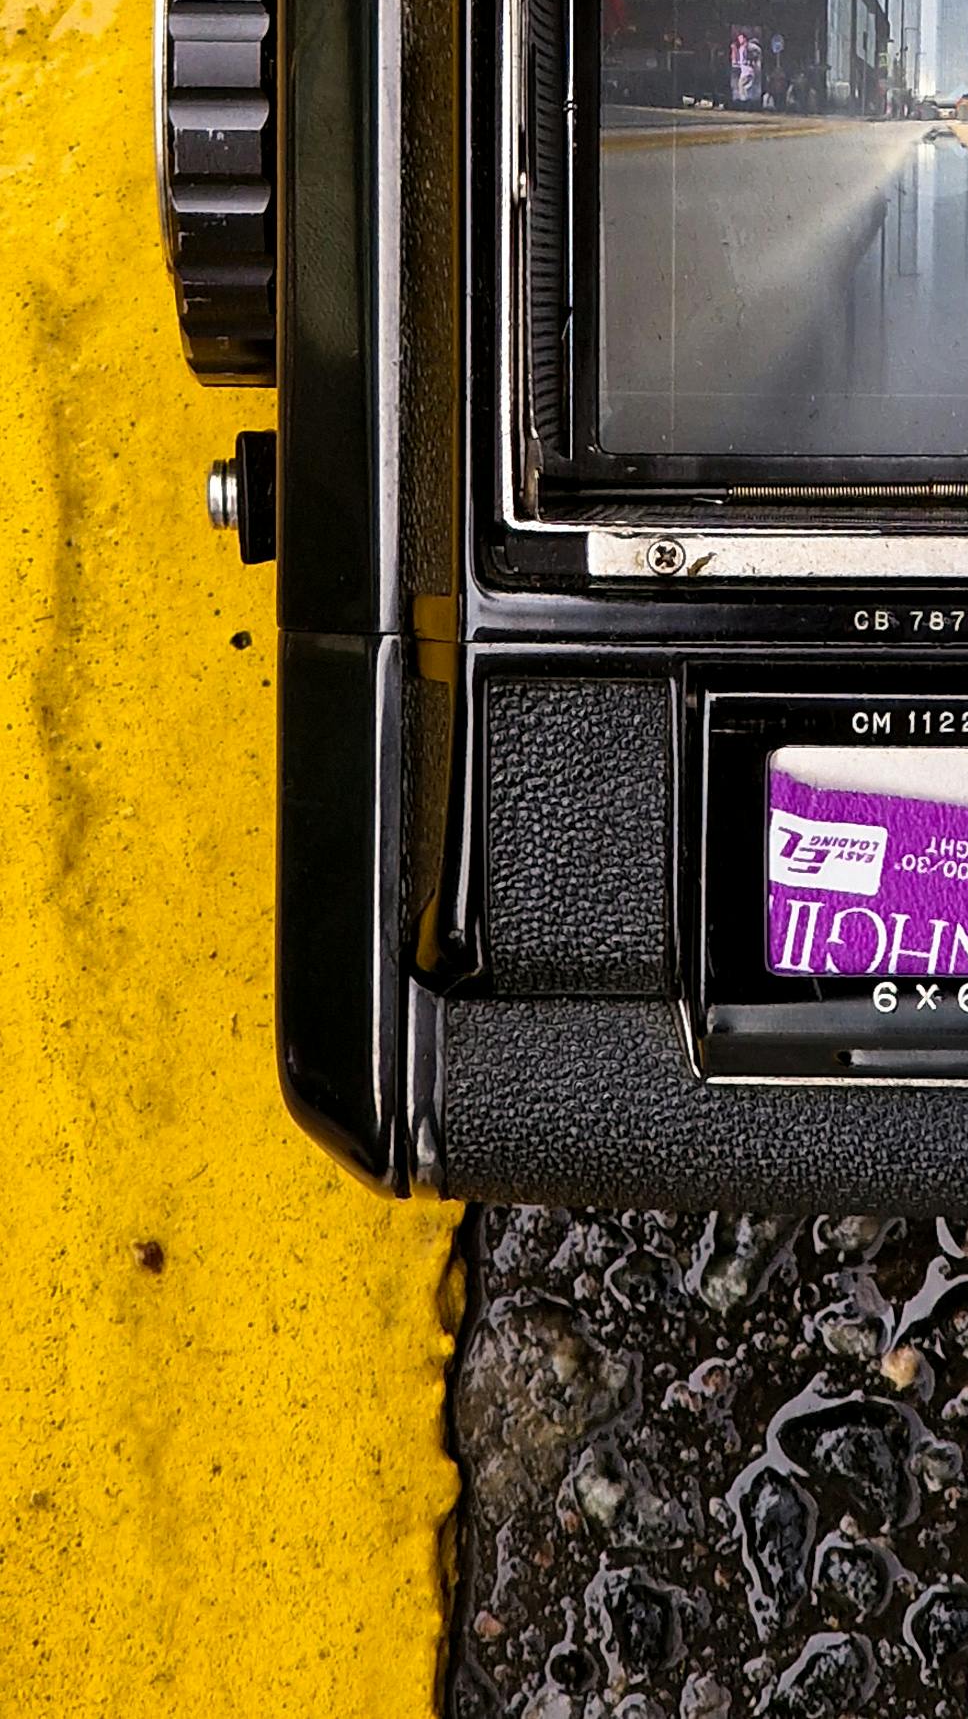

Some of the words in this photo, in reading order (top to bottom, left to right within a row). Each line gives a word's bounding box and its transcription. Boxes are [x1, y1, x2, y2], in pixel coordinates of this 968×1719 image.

[853, 610, 890, 632] CB
[851, 711, 892, 735] CM
[809, 834, 880, 852] LOADING
[834, 847, 875, 865] EASY
[871, 981, 899, 1014] 6
